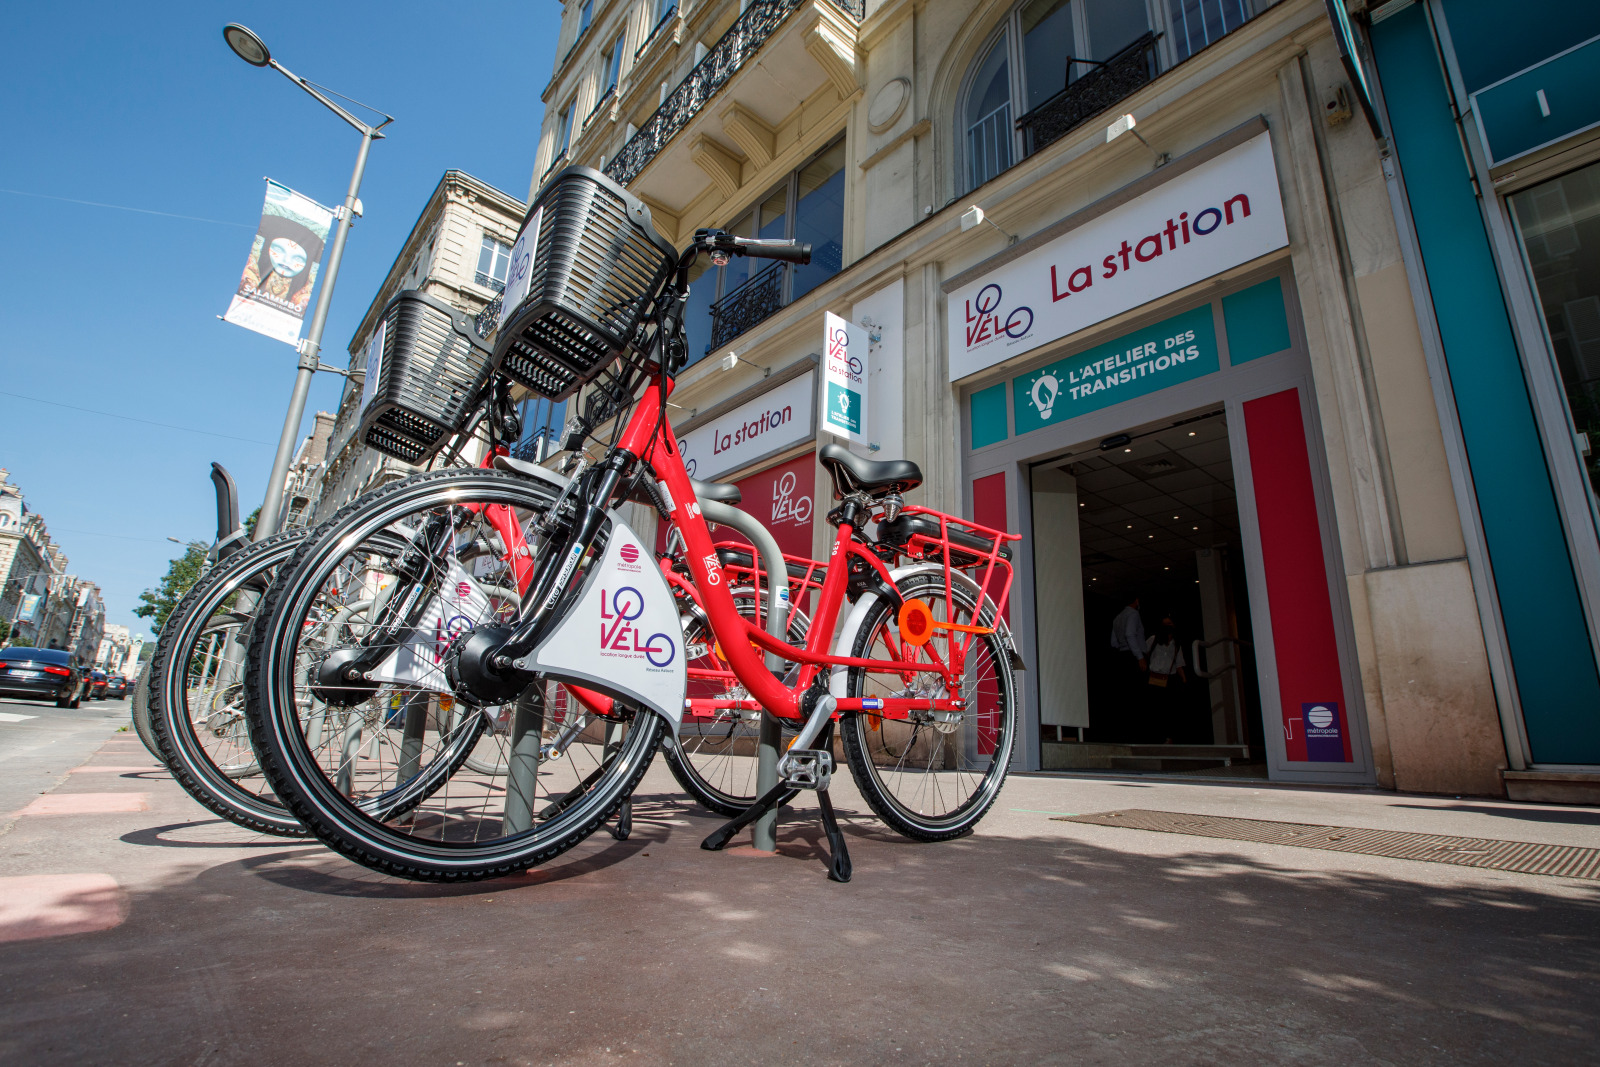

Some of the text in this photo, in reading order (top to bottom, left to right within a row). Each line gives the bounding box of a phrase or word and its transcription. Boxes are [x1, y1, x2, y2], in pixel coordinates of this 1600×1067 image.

[1050, 192, 1252, 303] La station
[967, 305, 1034, 347] VÉLO
[828, 360, 863, 385] La station
[1069, 329, 1196, 385] L'ATELIER DES
[1069, 344, 1200, 401] TRANSITIONS
[713, 405, 792, 456] La station
[601, 586, 645, 621] LO
[600, 620, 676, 668] VÉLO
